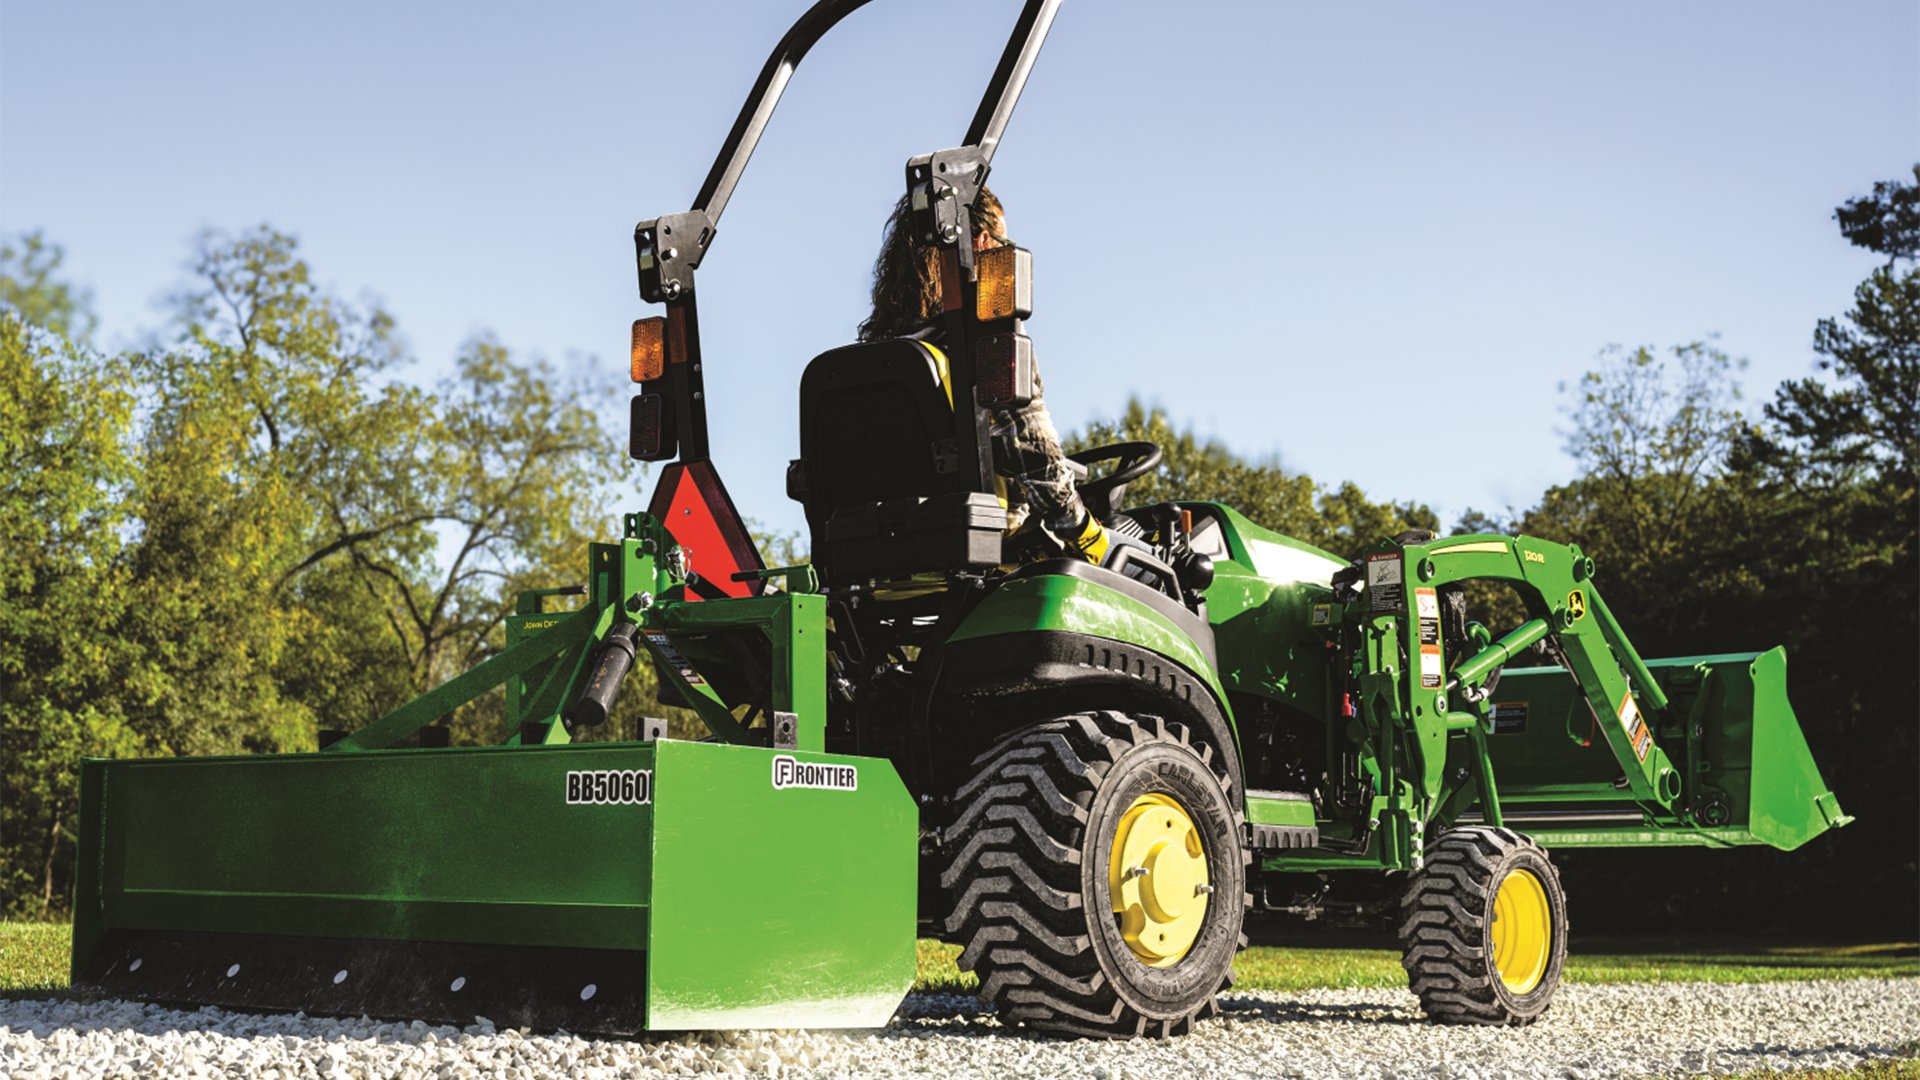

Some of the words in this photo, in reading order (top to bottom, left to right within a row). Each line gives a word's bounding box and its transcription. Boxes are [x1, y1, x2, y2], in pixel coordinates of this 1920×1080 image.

[523, 620, 543, 630] JOHN
[567, 771, 651, 802] BB5060
[775, 757, 855, 788] FRONTIER
